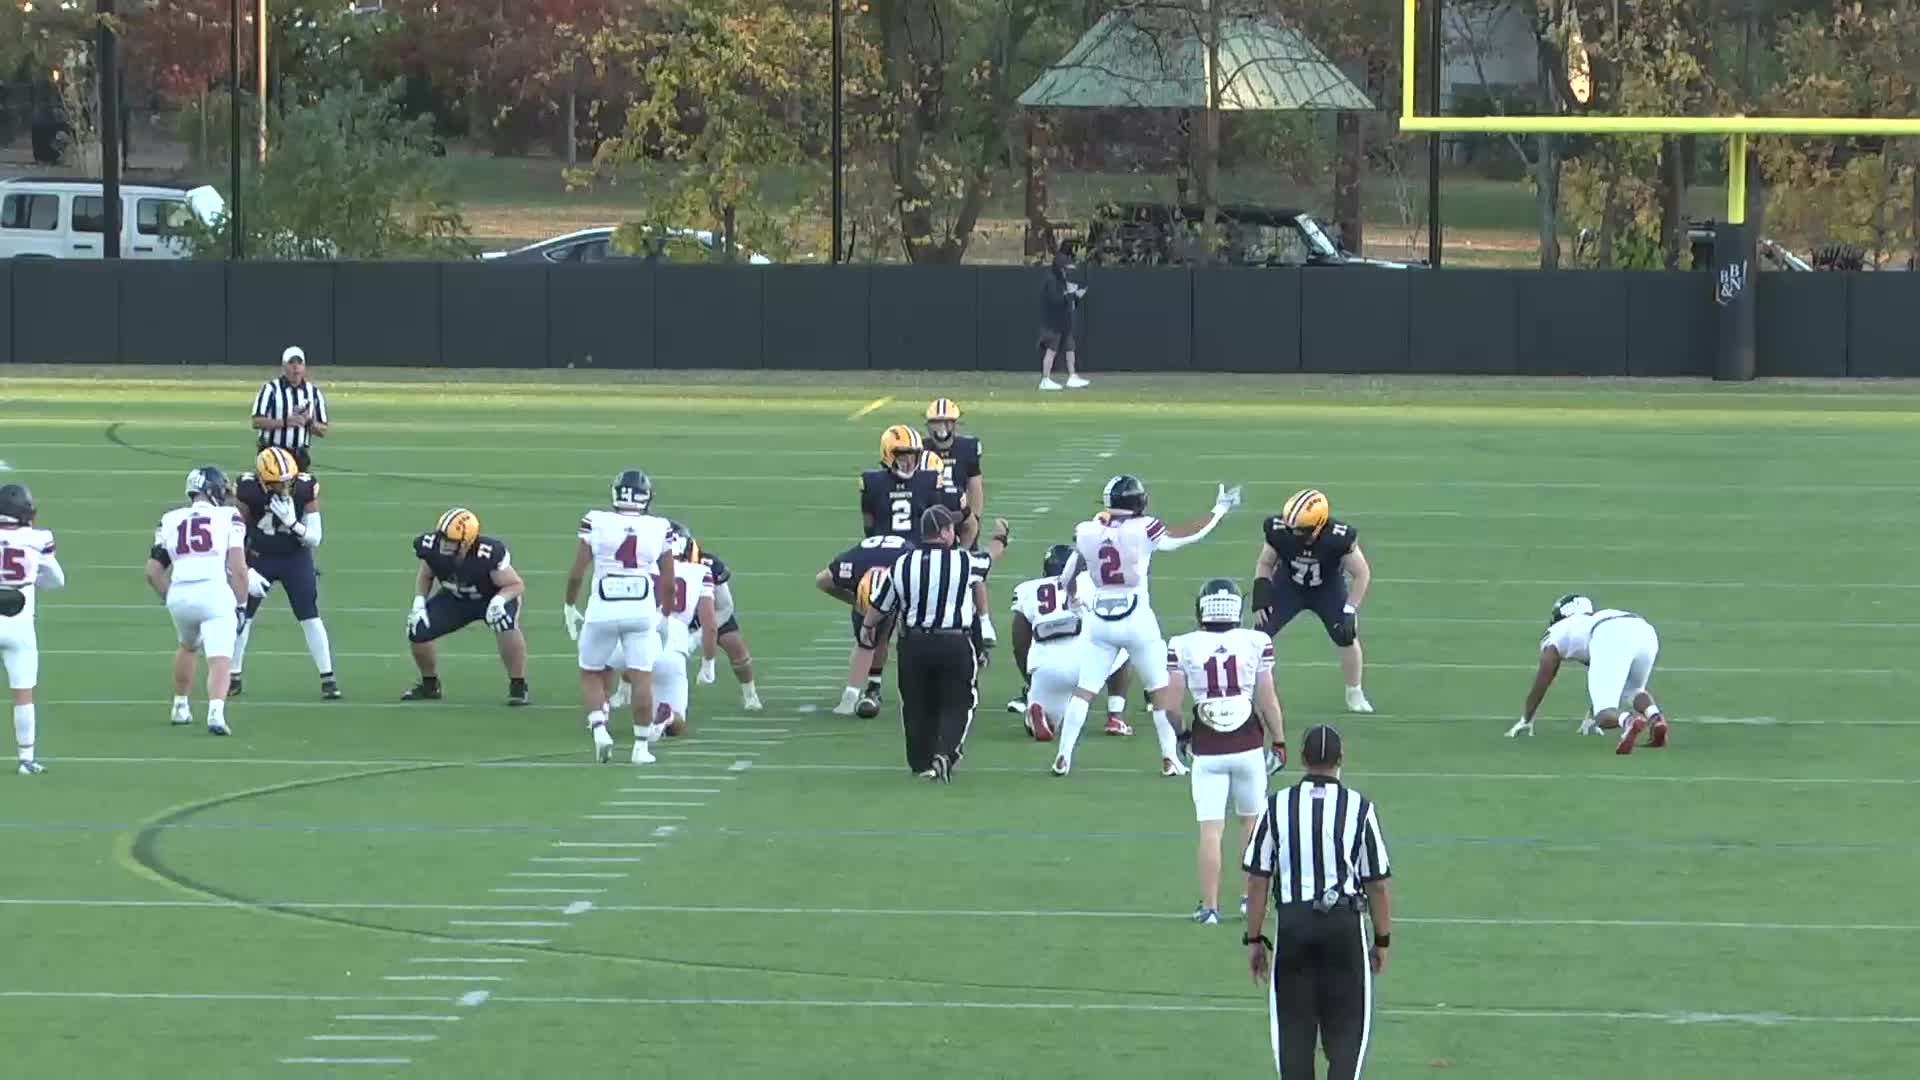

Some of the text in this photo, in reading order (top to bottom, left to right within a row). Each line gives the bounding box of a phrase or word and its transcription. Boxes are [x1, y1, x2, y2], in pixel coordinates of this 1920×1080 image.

[892, 499, 911, 531] 2
[175, 517, 213, 555] 15
[615, 535, 638, 569] 4
[0, 547, 26, 581] 5
[1098, 546, 1125, 585] 2
[1291, 560, 1323, 587] 71
[1203, 655, 1242, 699] 11
